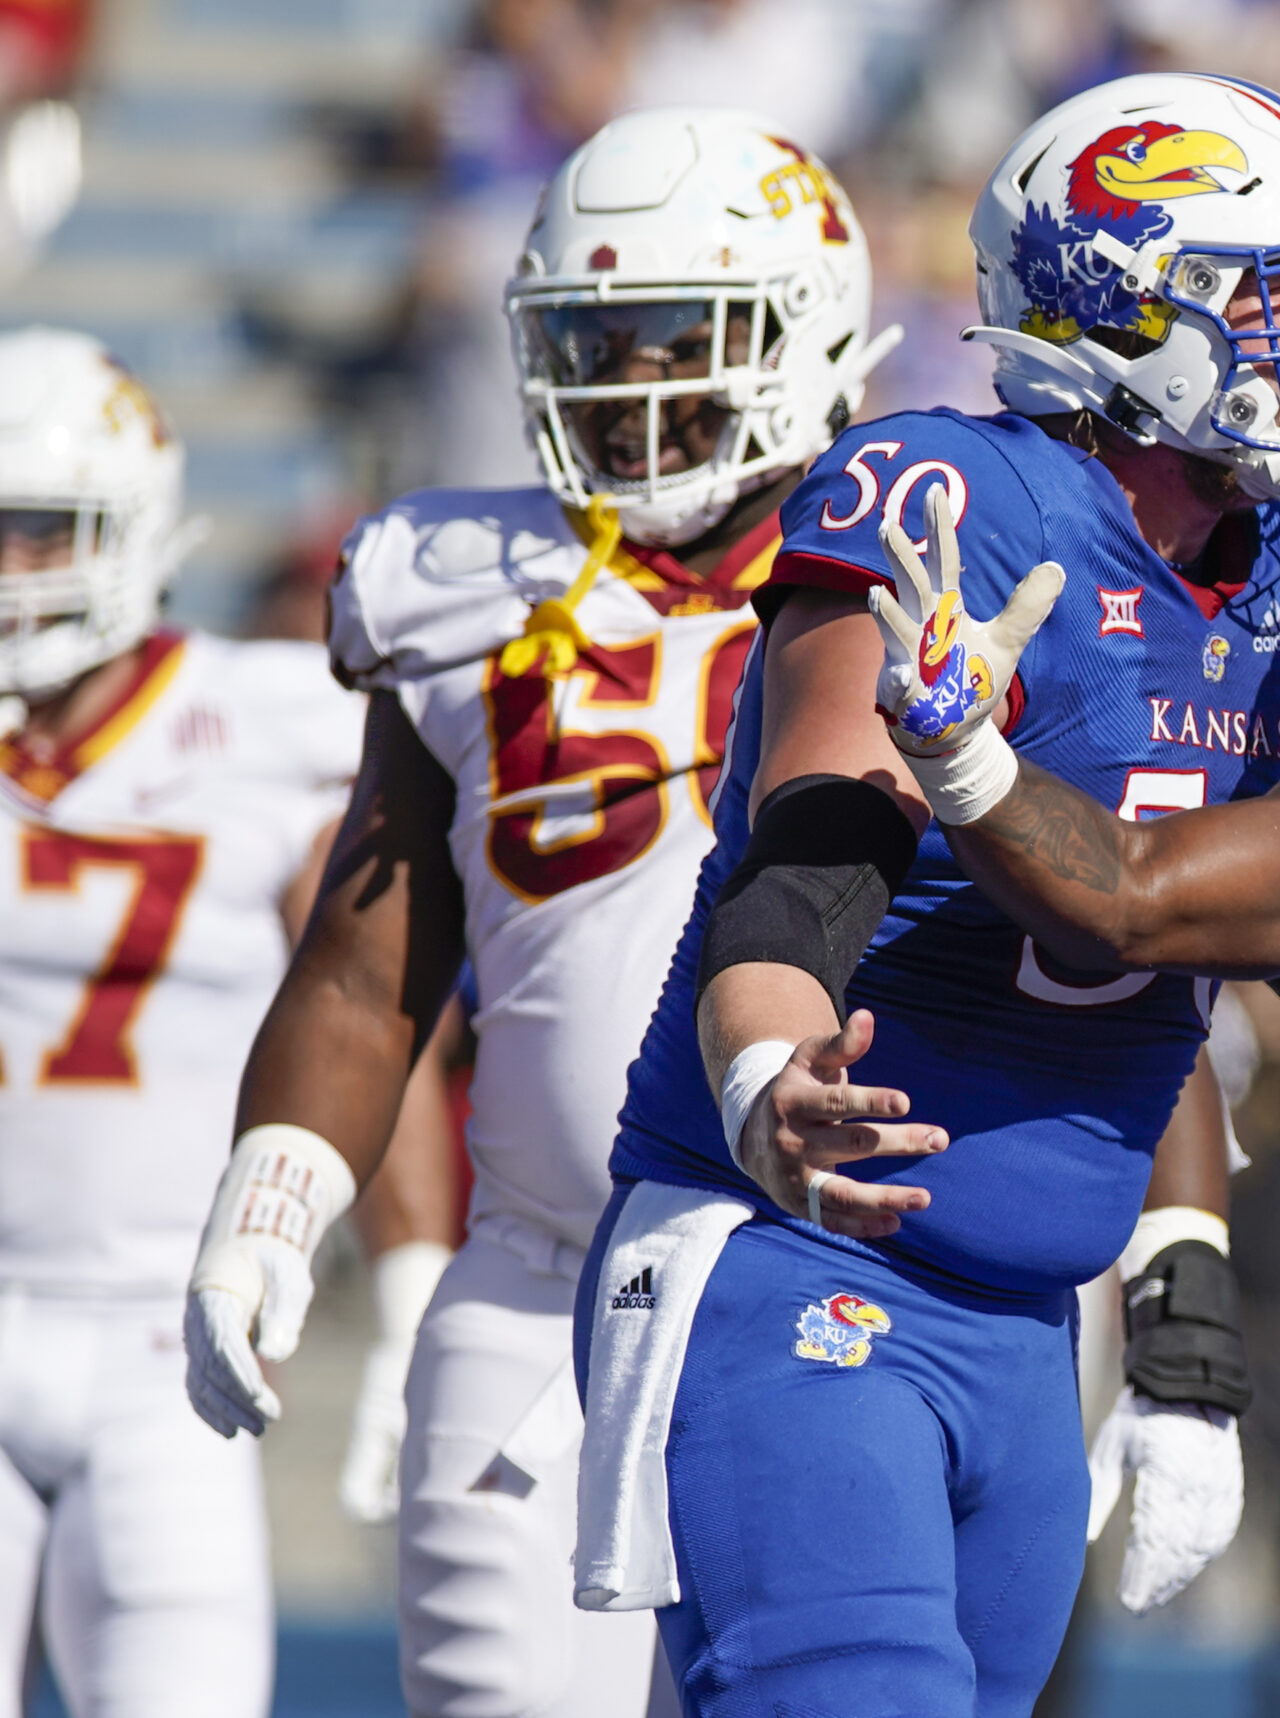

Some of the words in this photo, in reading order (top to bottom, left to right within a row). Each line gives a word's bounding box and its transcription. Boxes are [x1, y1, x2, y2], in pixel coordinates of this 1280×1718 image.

[1057, 240, 1114, 286] KU
[819, 440, 969, 555] 50
[611, 1293, 656, 1310] adidas
